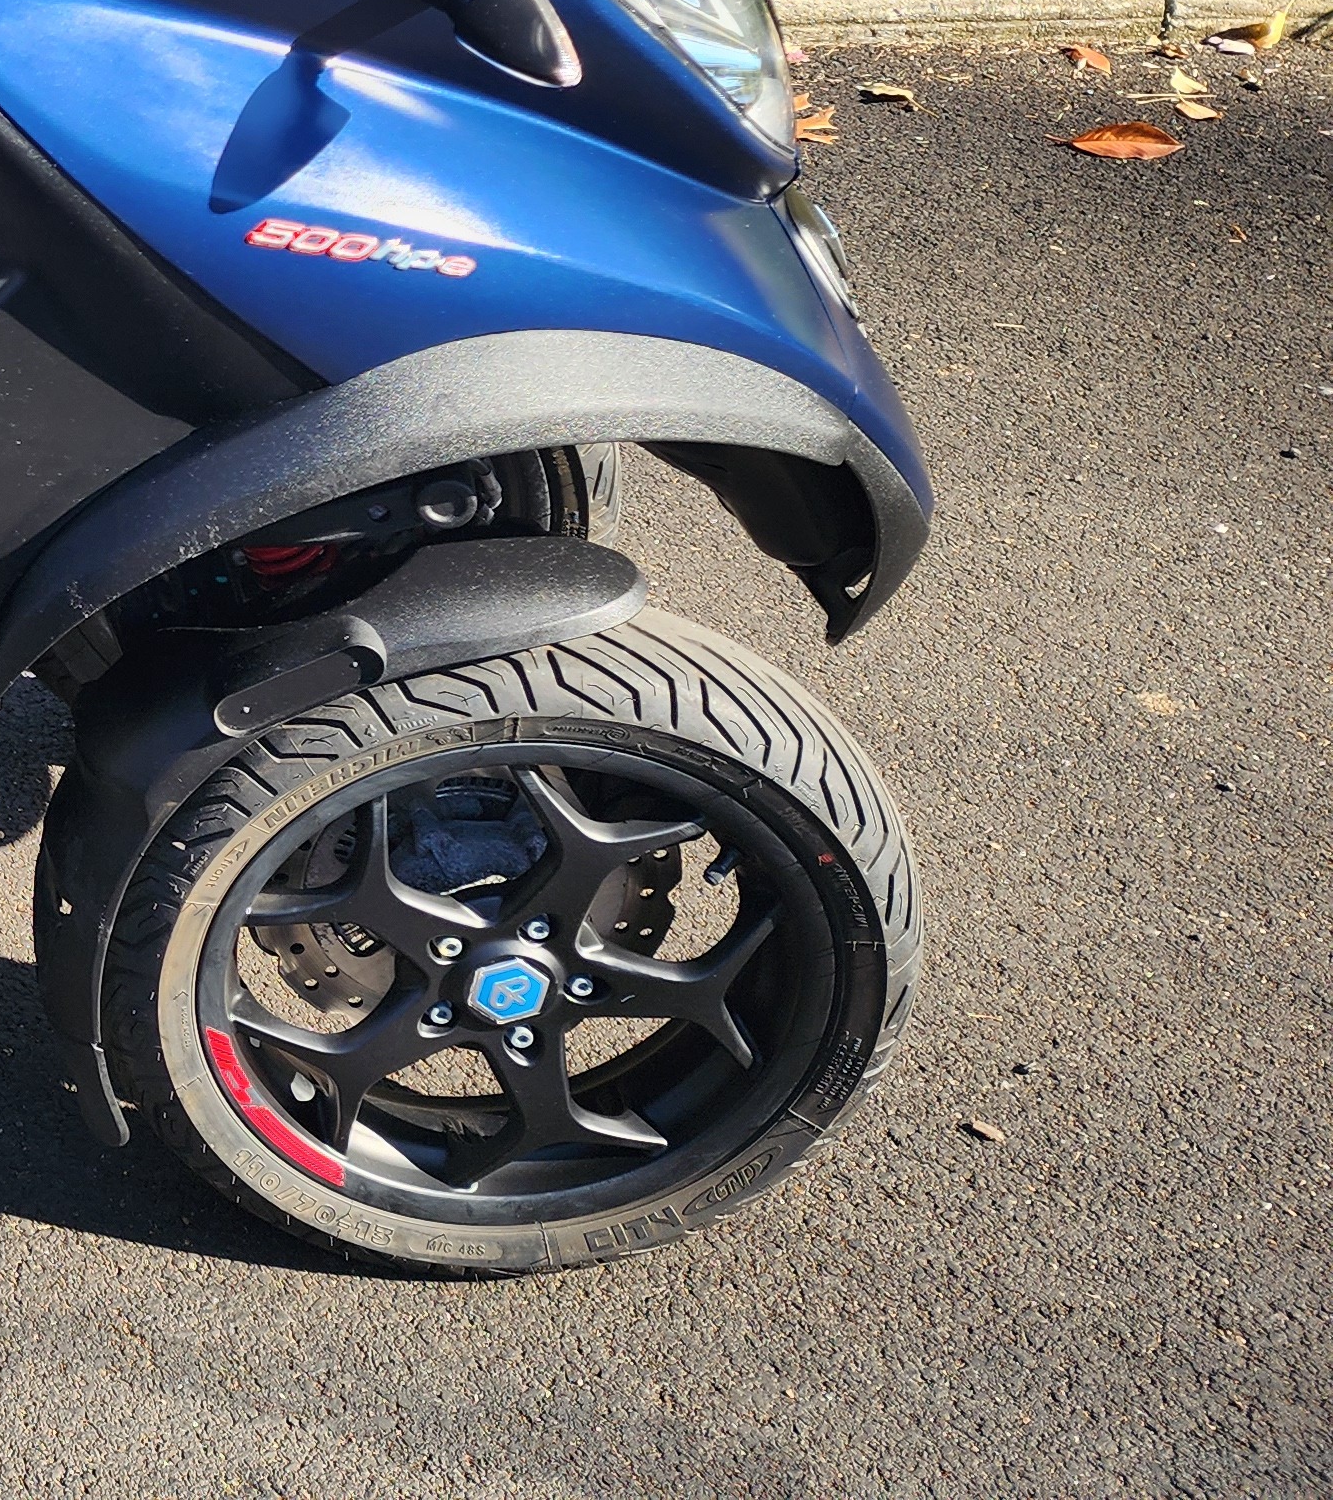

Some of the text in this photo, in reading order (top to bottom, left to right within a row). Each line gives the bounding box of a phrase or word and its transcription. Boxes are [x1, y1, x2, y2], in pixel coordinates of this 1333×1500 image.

[262, 738, 420, 830] MICHELIN
[206, 856, 235, 889] front
[583, 1162, 758, 1252] CITY GRIP
